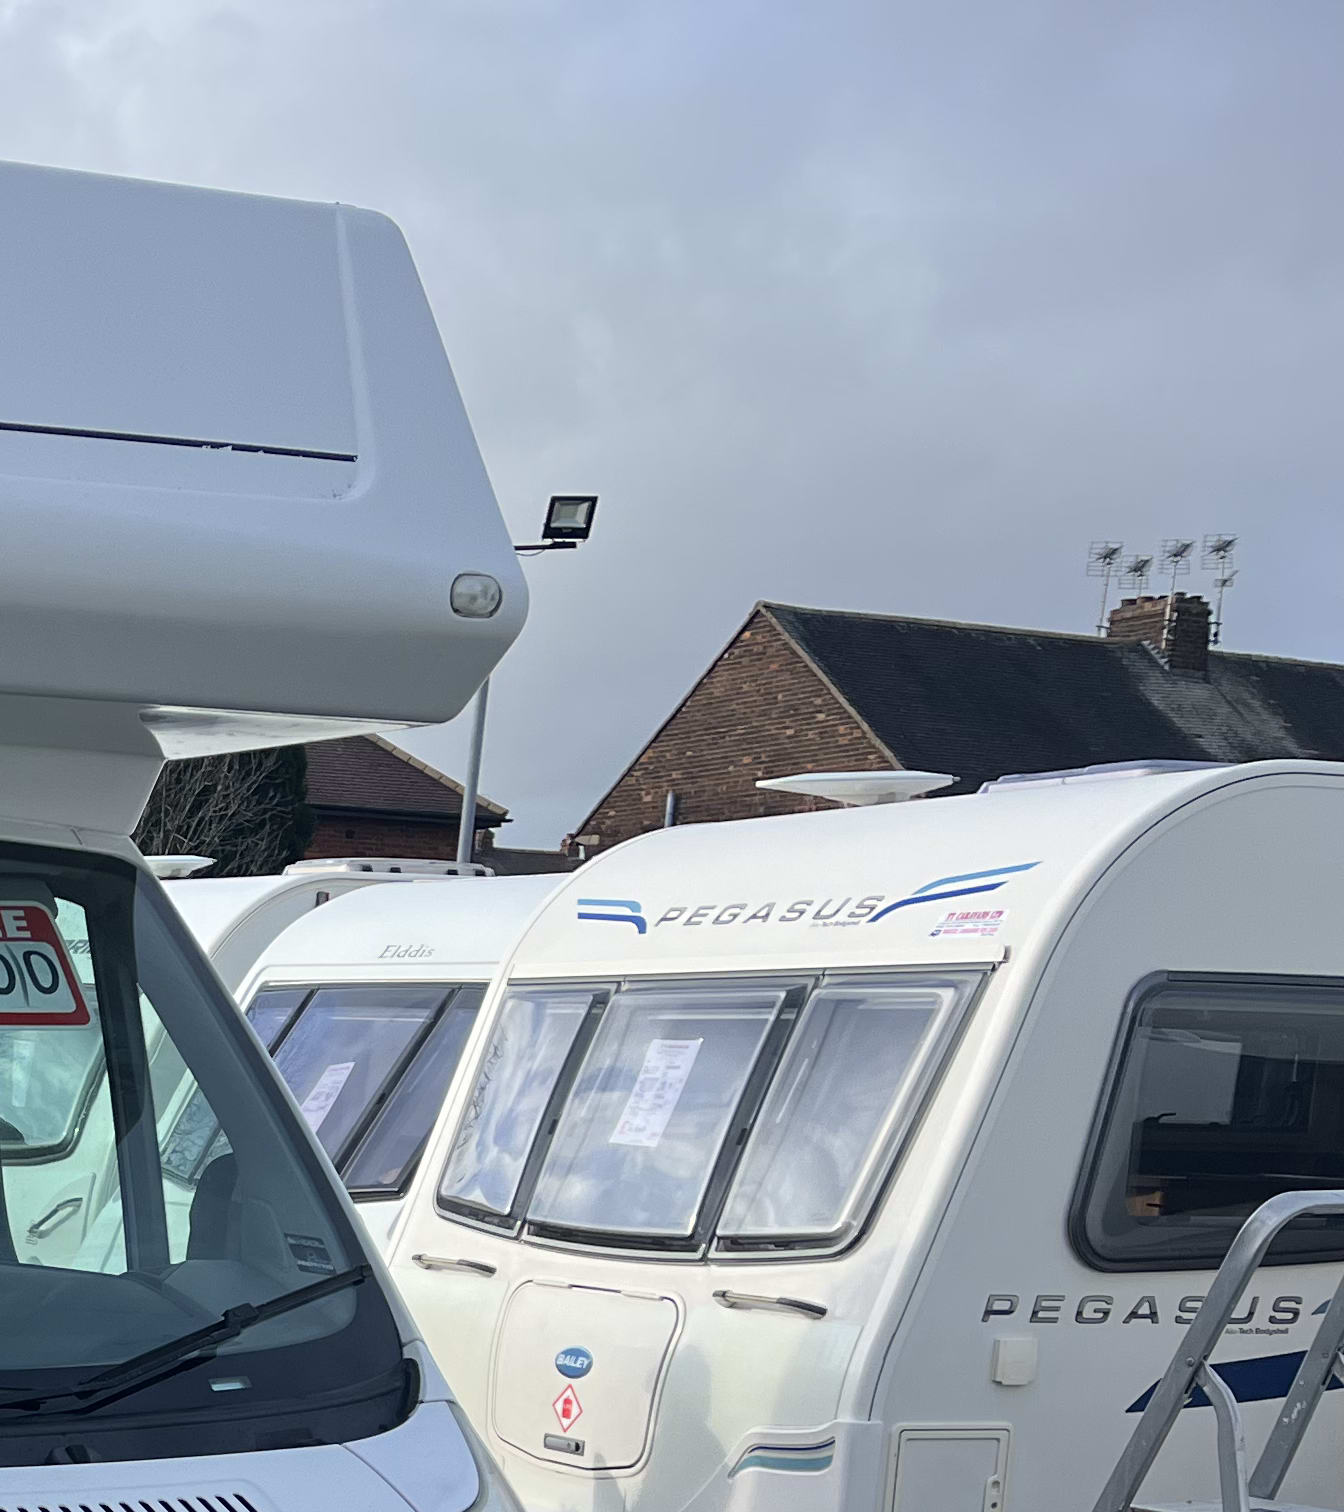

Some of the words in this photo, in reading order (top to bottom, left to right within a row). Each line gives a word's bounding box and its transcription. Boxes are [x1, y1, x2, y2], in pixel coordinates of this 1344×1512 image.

[655, 895, 885, 928] PEGASUS
[377, 943, 435, 959] Elddis
[981, 1294, 1303, 1325] PEGASUS
[556, 1353, 592, 1369] BAILEY
